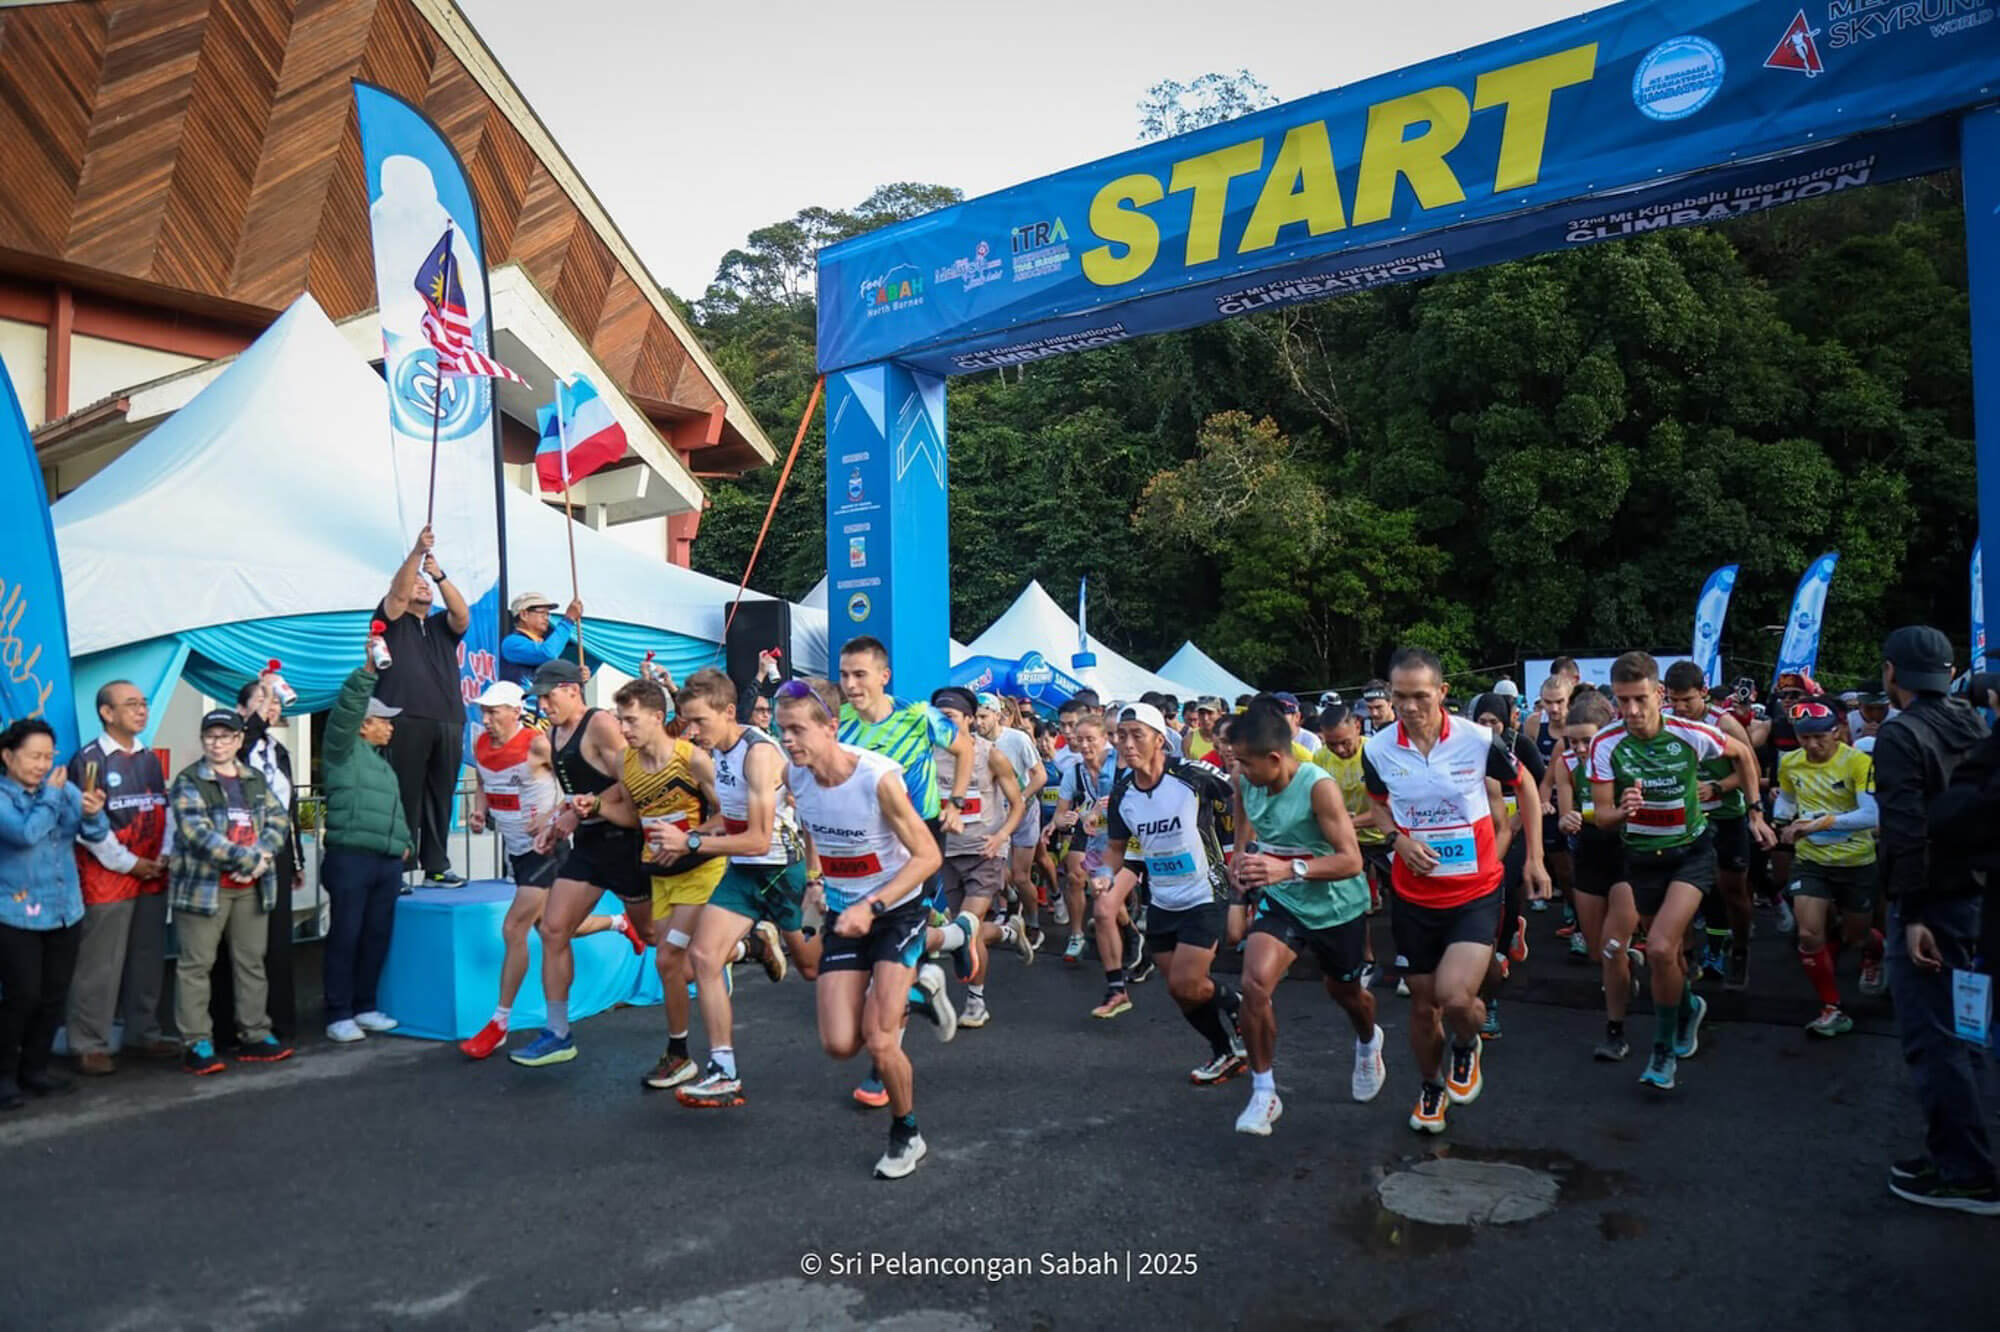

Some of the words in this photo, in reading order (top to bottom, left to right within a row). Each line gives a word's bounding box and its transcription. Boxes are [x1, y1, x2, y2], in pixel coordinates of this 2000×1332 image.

[1828, 0, 1986, 49] SKYRUN
[1929, 8, 1994, 38] WORLD
[1081, 42, 1599, 287] START
[1566, 169, 1871, 243] CLIMBATHON
[1609, 209, 1634, 224] Mt
[1638, 190, 1729, 217] Kinabalu
[1735, 155, 1876, 198] International
[1219, 258, 1446, 315] CLIMBATHON
[1246, 285, 1266, 297] Mt
[1268, 272, 1336, 292] Kinabalu
[1339, 249, 1443, 278] International
[866, 276, 924, 308] SABAH
[867, 302, 891, 318] North
[957, 332, 1132, 370] CLIMBATHON
[976, 349, 990, 358] Mt
[992, 340, 1044, 357] Kinabalu
[1045, 322, 1125, 346] International
[812, 823, 864, 838] SCARPA
[1137, 815, 1182, 836] FUGA
[1153, 858, 1184, 873] C301
